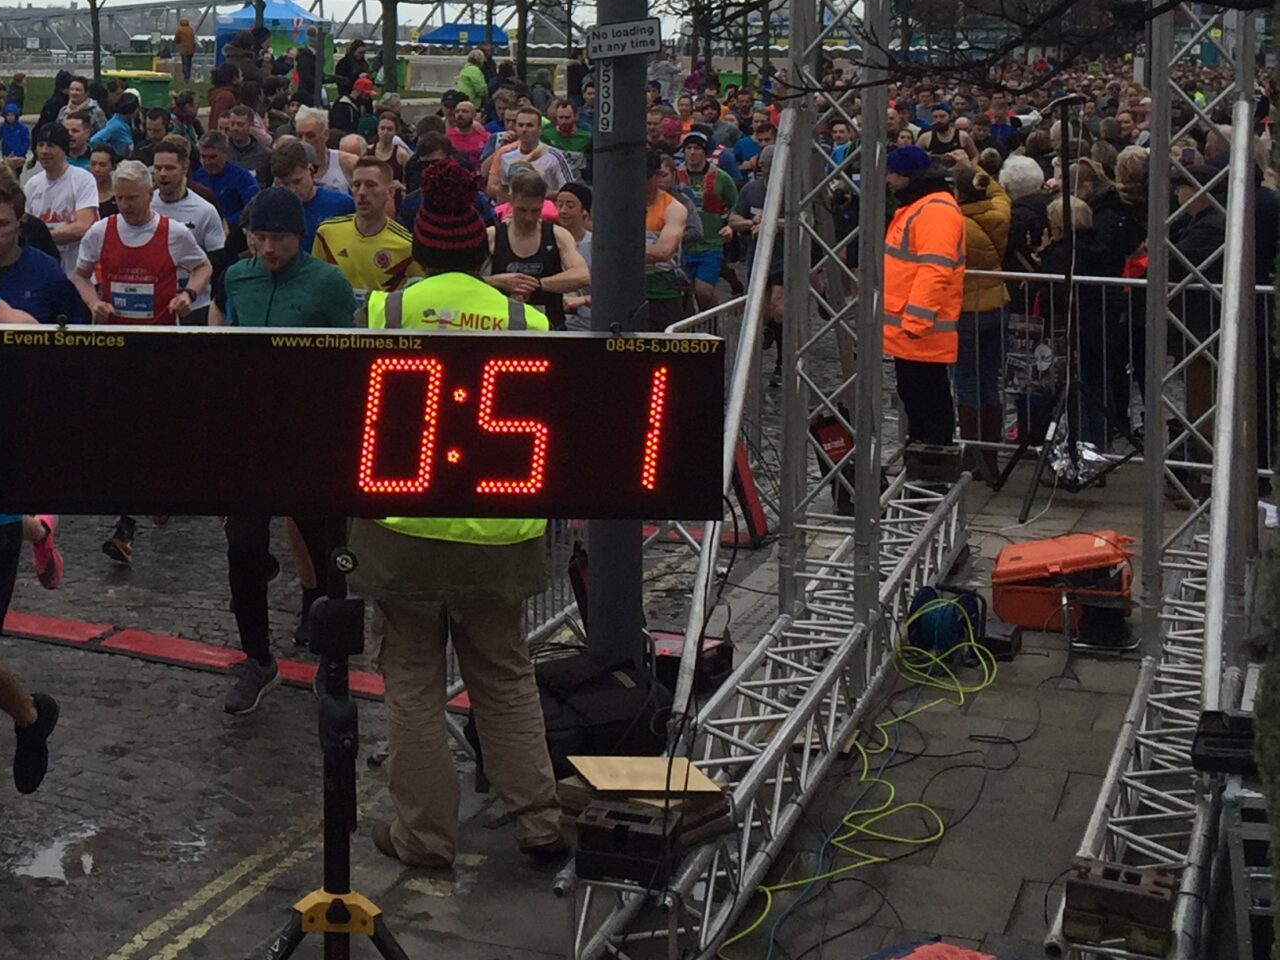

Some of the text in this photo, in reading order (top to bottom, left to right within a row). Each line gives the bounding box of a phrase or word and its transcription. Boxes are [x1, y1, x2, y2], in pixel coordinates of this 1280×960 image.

[591, 26, 654, 41] No loading
[591, 38, 656, 53] at any time
[460, 312, 504, 331] MICK
[3, 330, 50, 345] Event
[54, 331, 125, 347] Services
[270, 334, 423, 350] www.chiptimes.biz
